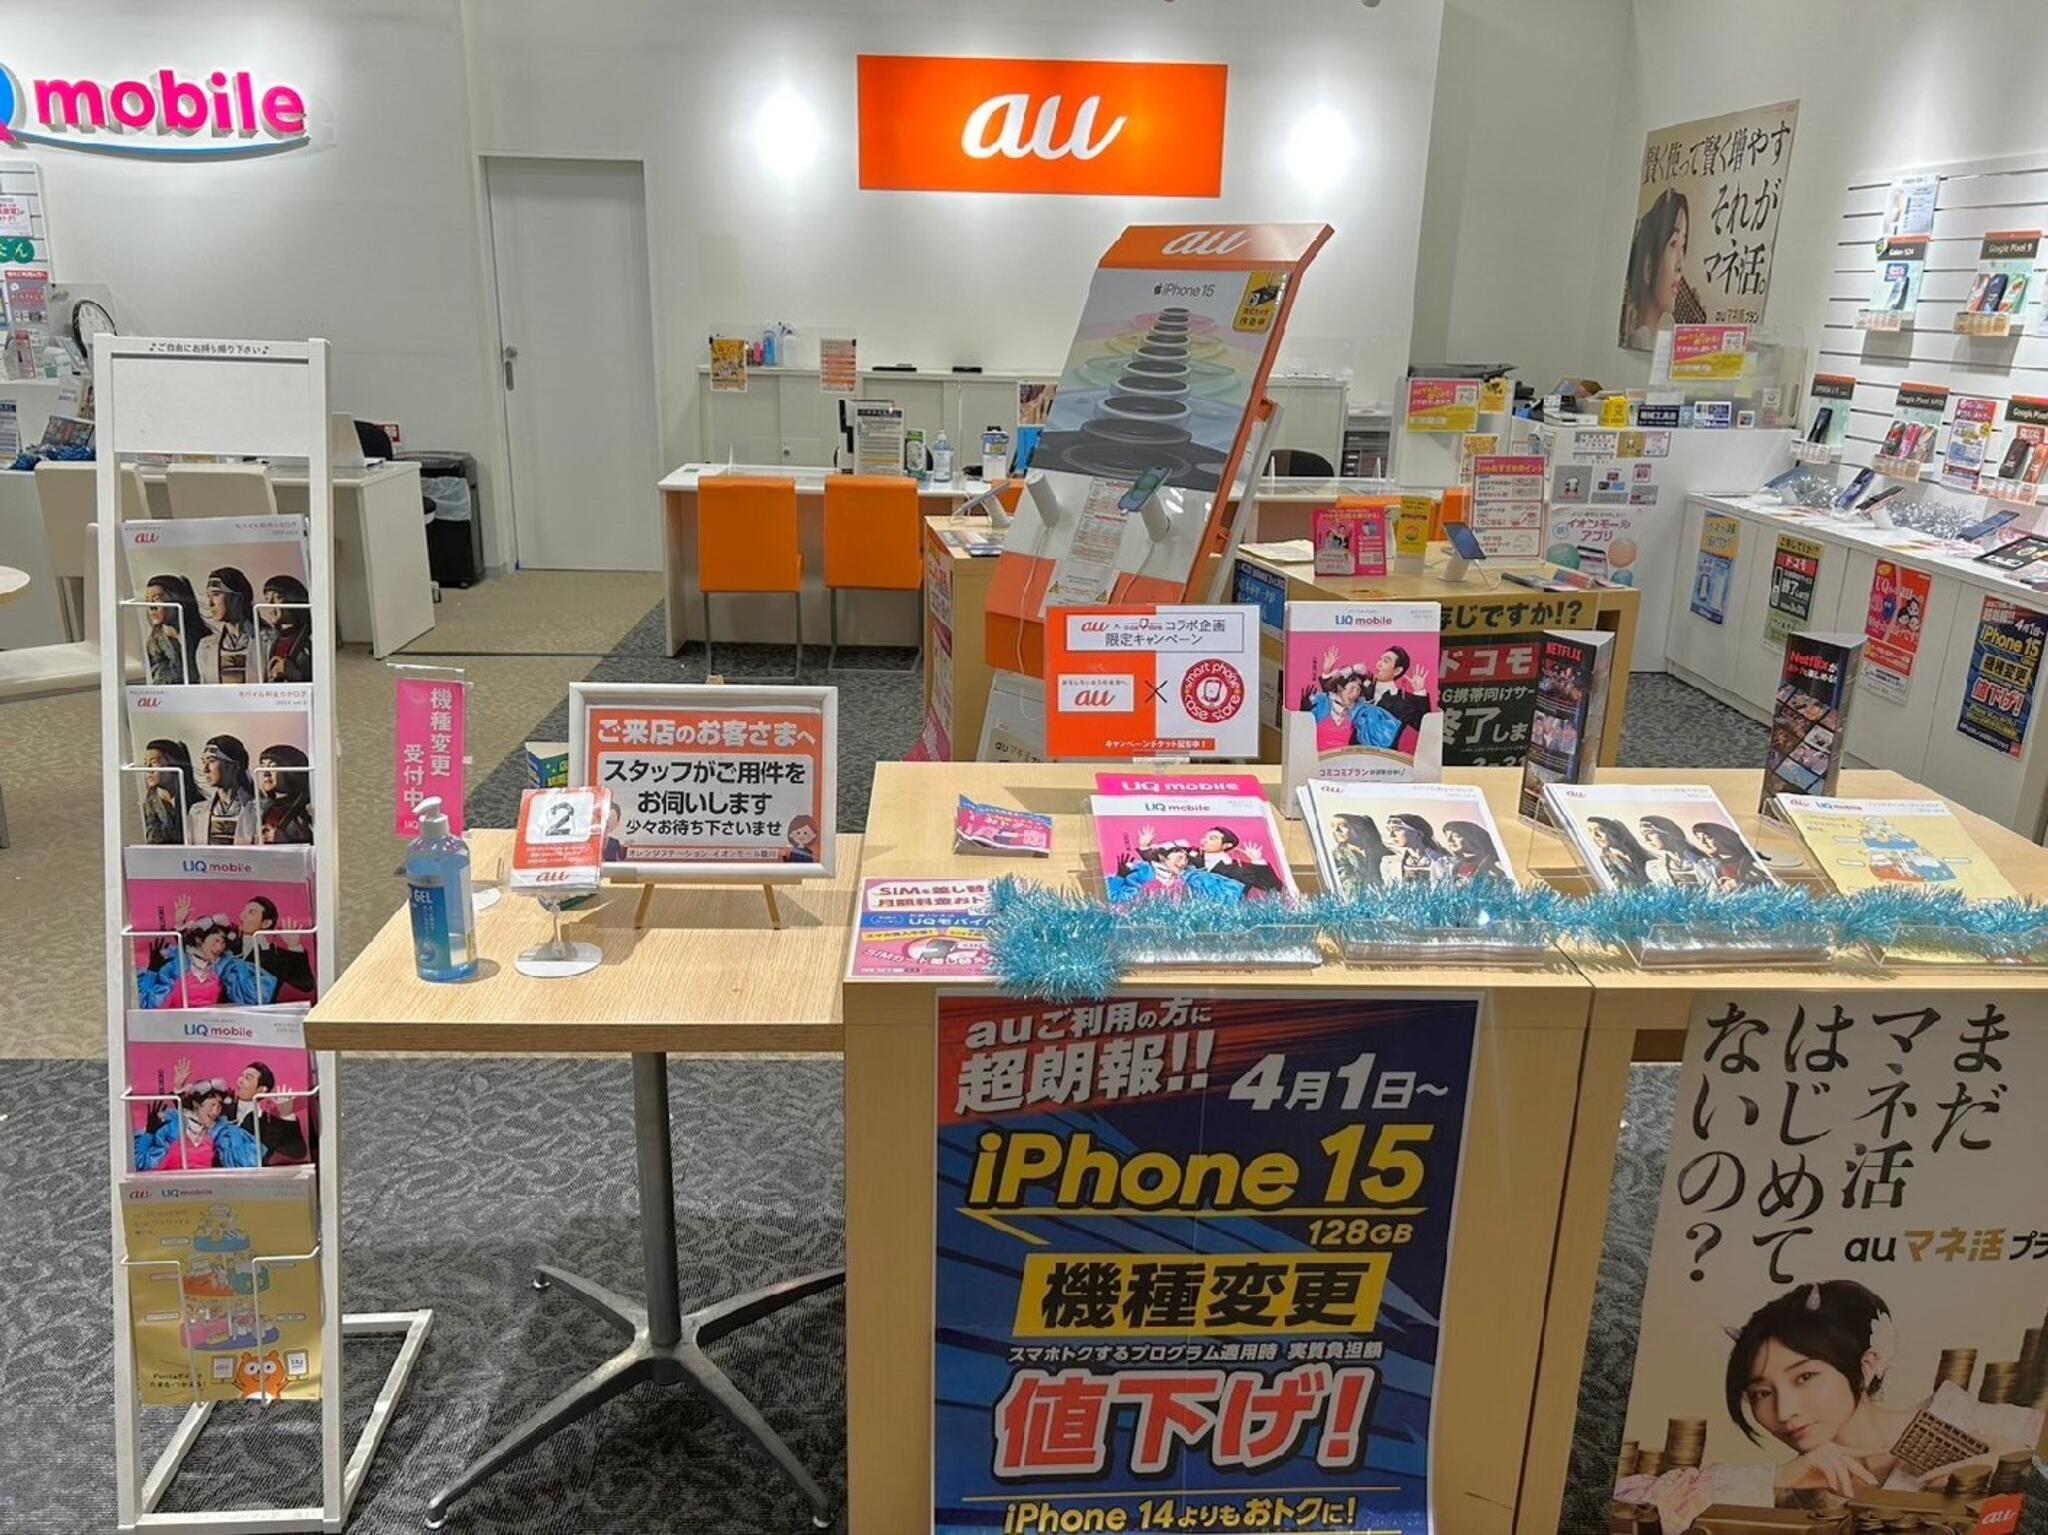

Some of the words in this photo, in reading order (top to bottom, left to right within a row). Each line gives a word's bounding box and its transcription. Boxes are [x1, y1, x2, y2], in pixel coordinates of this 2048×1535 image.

[34, 70, 306, 134] mobile
[961, 94, 1127, 160] au
[1643, 120, 1791, 185] 賢く使って賢く増やす
[1711, 178, 1783, 236] それが
[1161, 231, 1253, 255] au
[1704, 239, 1767, 296] マネ活。
[1162, 282, 1200, 297] iPhone
[1201, 284, 1216, 297] 15
[134, 532, 160, 544] au
[1081, 620, 1109, 633] au
[1165, 619, 1226, 633] コラボ企画
[1335, 615, 1353, 626] UQ
[1355, 615, 1392, 626] mobile
[1105, 633, 1203, 647] 限定キャンペーン
[1546, 641, 1584, 663] NETFLIX
[1981, 625, 2023, 652] iPhone
[1184, 662, 1210, 688] smart
[1212, 661, 1240, 689] phone
[1440, 645, 1535, 679] ドコモ
[137, 695, 161, 708] au
[1075, 689, 1116, 706] au
[1184, 695, 1209, 720] case
[1212, 694, 1241, 720] store
[429, 687, 453, 777] 機種変更
[597, 718, 817, 747] ご来店のお客さまへ
[403, 743, 425, 809] 受付中
[603, 759, 806, 785] スタッフがご用件を
[1122, 781, 1161, 792] UQ
[1165, 781, 1239, 791] mobile
[637, 789, 773, 815] お伺いします
[1145, 802, 1166, 812] UQ
[1168, 803, 1210, 812] mobile
[545, 802, 575, 836] 2
[625, 819, 782, 837] 少々お待ち下さいませ
[183, 860, 207, 873] UQ
[209, 861, 252, 873] mobile
[536, 870, 569, 882] au
[184, 1024, 208, 1037] UQ
[210, 1025, 253, 1037] mobile
[964, 997, 1213, 1049] auご利用の方に
[954, 1029, 1215, 1115] 超朗報!!
[1931, 1003, 2010, 1154] まだ
[1841, 1006, 1942, 1210] マネ活
[1677, 1002, 1770, 1283] ないの?
[1753, 1003, 1855, 1285] はじめて
[967, 1131, 1299, 1206] iPhone
[1320, 1124, 1434, 1203] 15
[1308, 1219, 1414, 1247] 128GB
[1041, 1262, 1370, 1329] 機種変更
[1008, 1342, 1277, 1363] スマホトクするプログラム適用時
[1287, 1340, 1384, 1360] 実質負担額
[998, 1366, 1371, 1473] 値下げ!
[1004, 1501, 1127, 1535] iPhone
[1981, 1507, 2023, 1527] au
